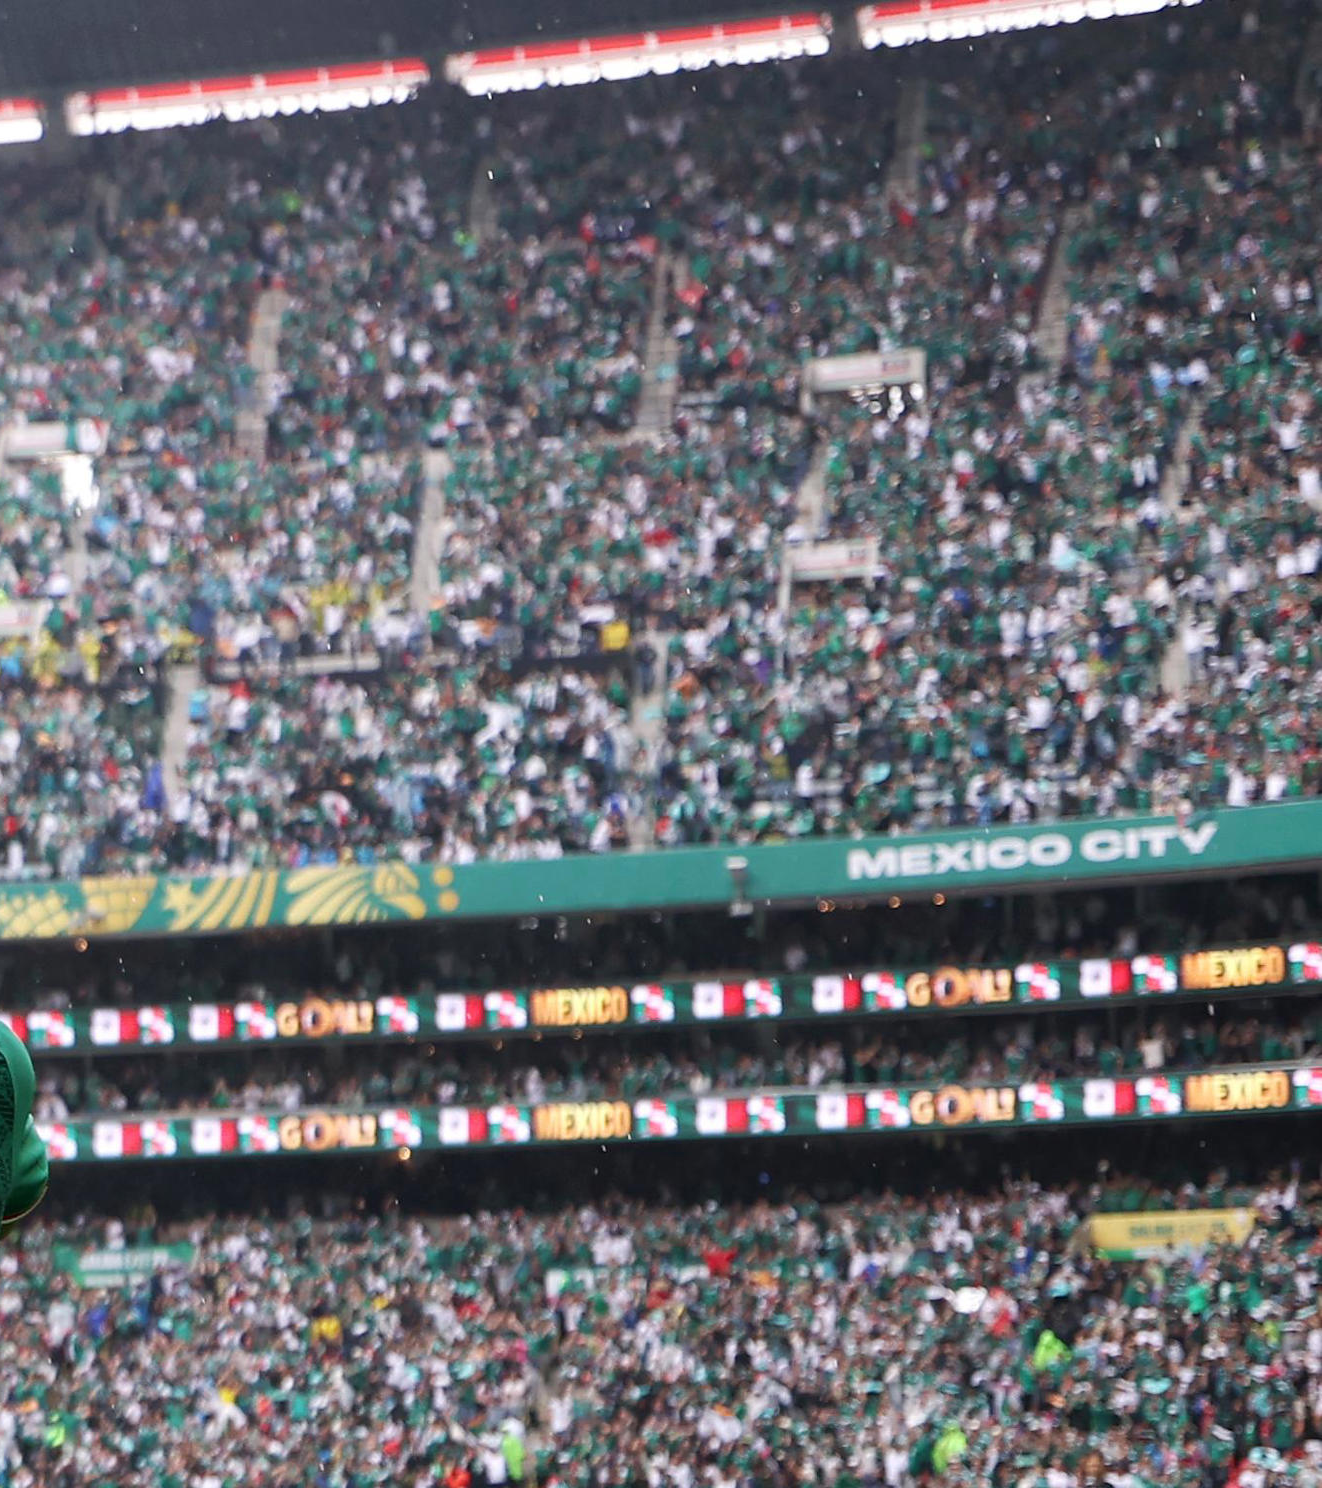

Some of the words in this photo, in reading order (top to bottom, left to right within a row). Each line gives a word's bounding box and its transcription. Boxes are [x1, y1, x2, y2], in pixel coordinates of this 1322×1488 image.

[847, 833, 1073, 881] MEXICO
[1080, 821, 1219, 863] CITY
[530, 986, 628, 1026] MEXICO
[533, 1101, 632, 1140] MEXICO
